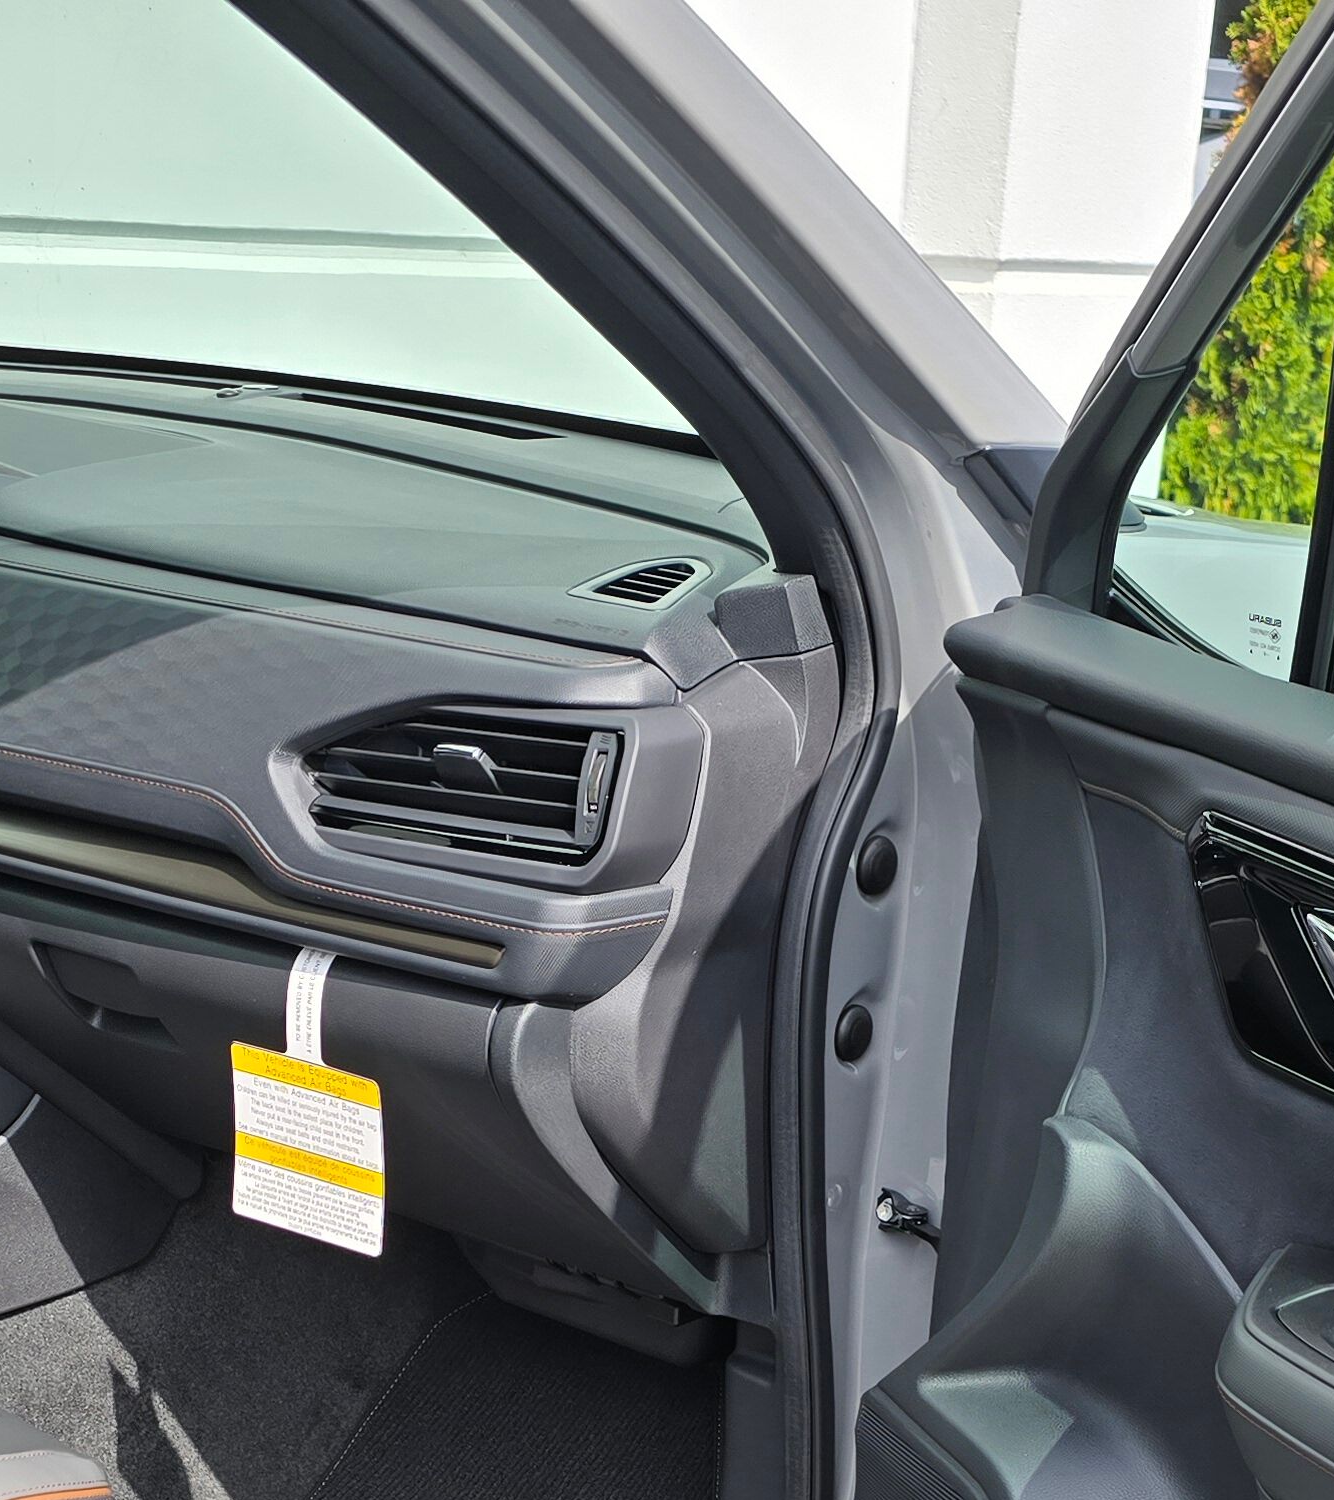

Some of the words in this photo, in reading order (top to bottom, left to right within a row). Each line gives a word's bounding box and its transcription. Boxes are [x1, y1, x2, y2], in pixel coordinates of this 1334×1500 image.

[242, 1047, 260, 1060] This
[263, 1053, 294, 1070] Vehicle
[309, 1064, 347, 1086] Equipped
[351, 1079, 368, 1091] with
[265, 1065, 307, 1085] Advanced
[310, 1077, 322, 1088] Air
[326, 1081, 347, 1098] Bags
[253, 1077, 271, 1090] Even
[274, 1084, 289, 1094] with
[291, 1088, 326, 1106] Advanced
[329, 1098, 339, 1109] Air
[341, 1101, 360, 1116] Bags
